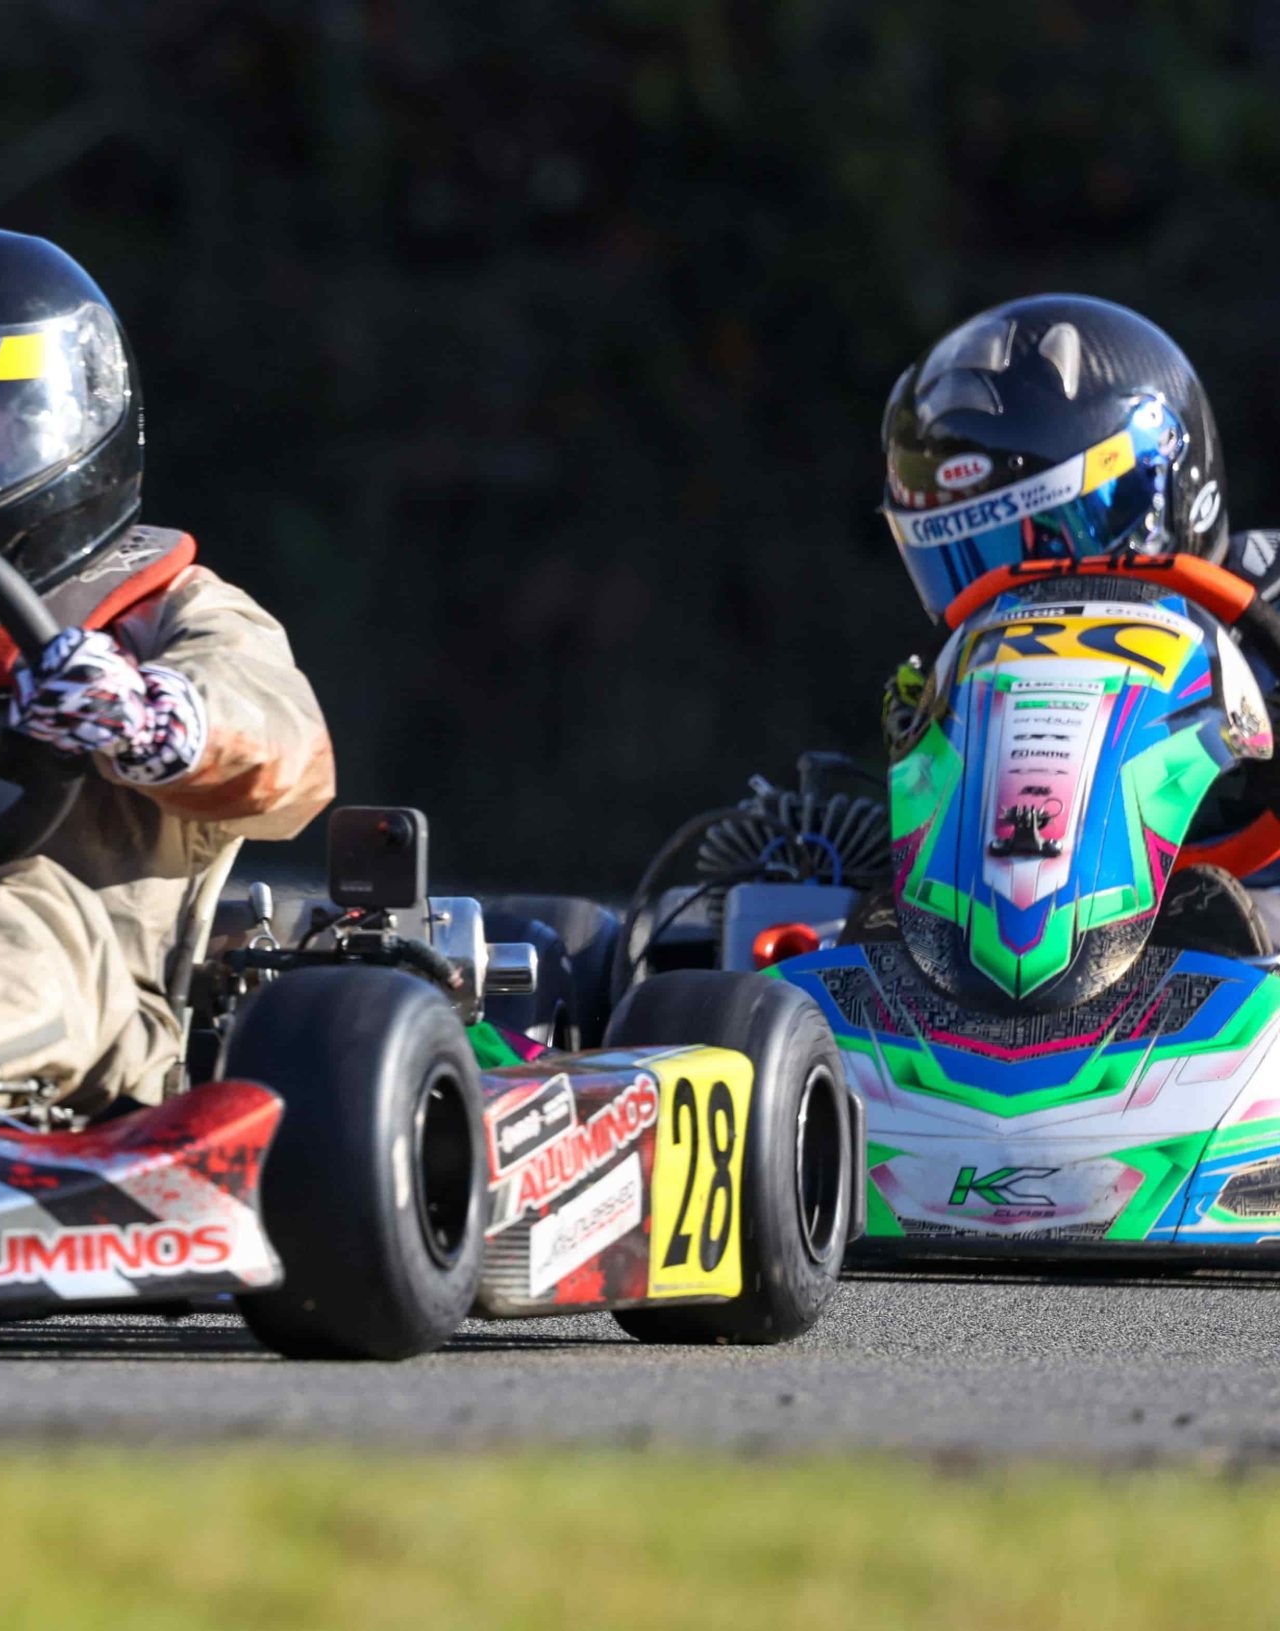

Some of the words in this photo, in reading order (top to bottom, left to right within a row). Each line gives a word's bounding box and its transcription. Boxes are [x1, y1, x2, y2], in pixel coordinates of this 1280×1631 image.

[943, 460, 983, 481] BELL
[911, 493, 1019, 542] CARTER'S
[517, 1078, 657, 1215] ALUMINOS
[661, 1076, 736, 1273] 28
[948, 1166, 1061, 1207] KC
